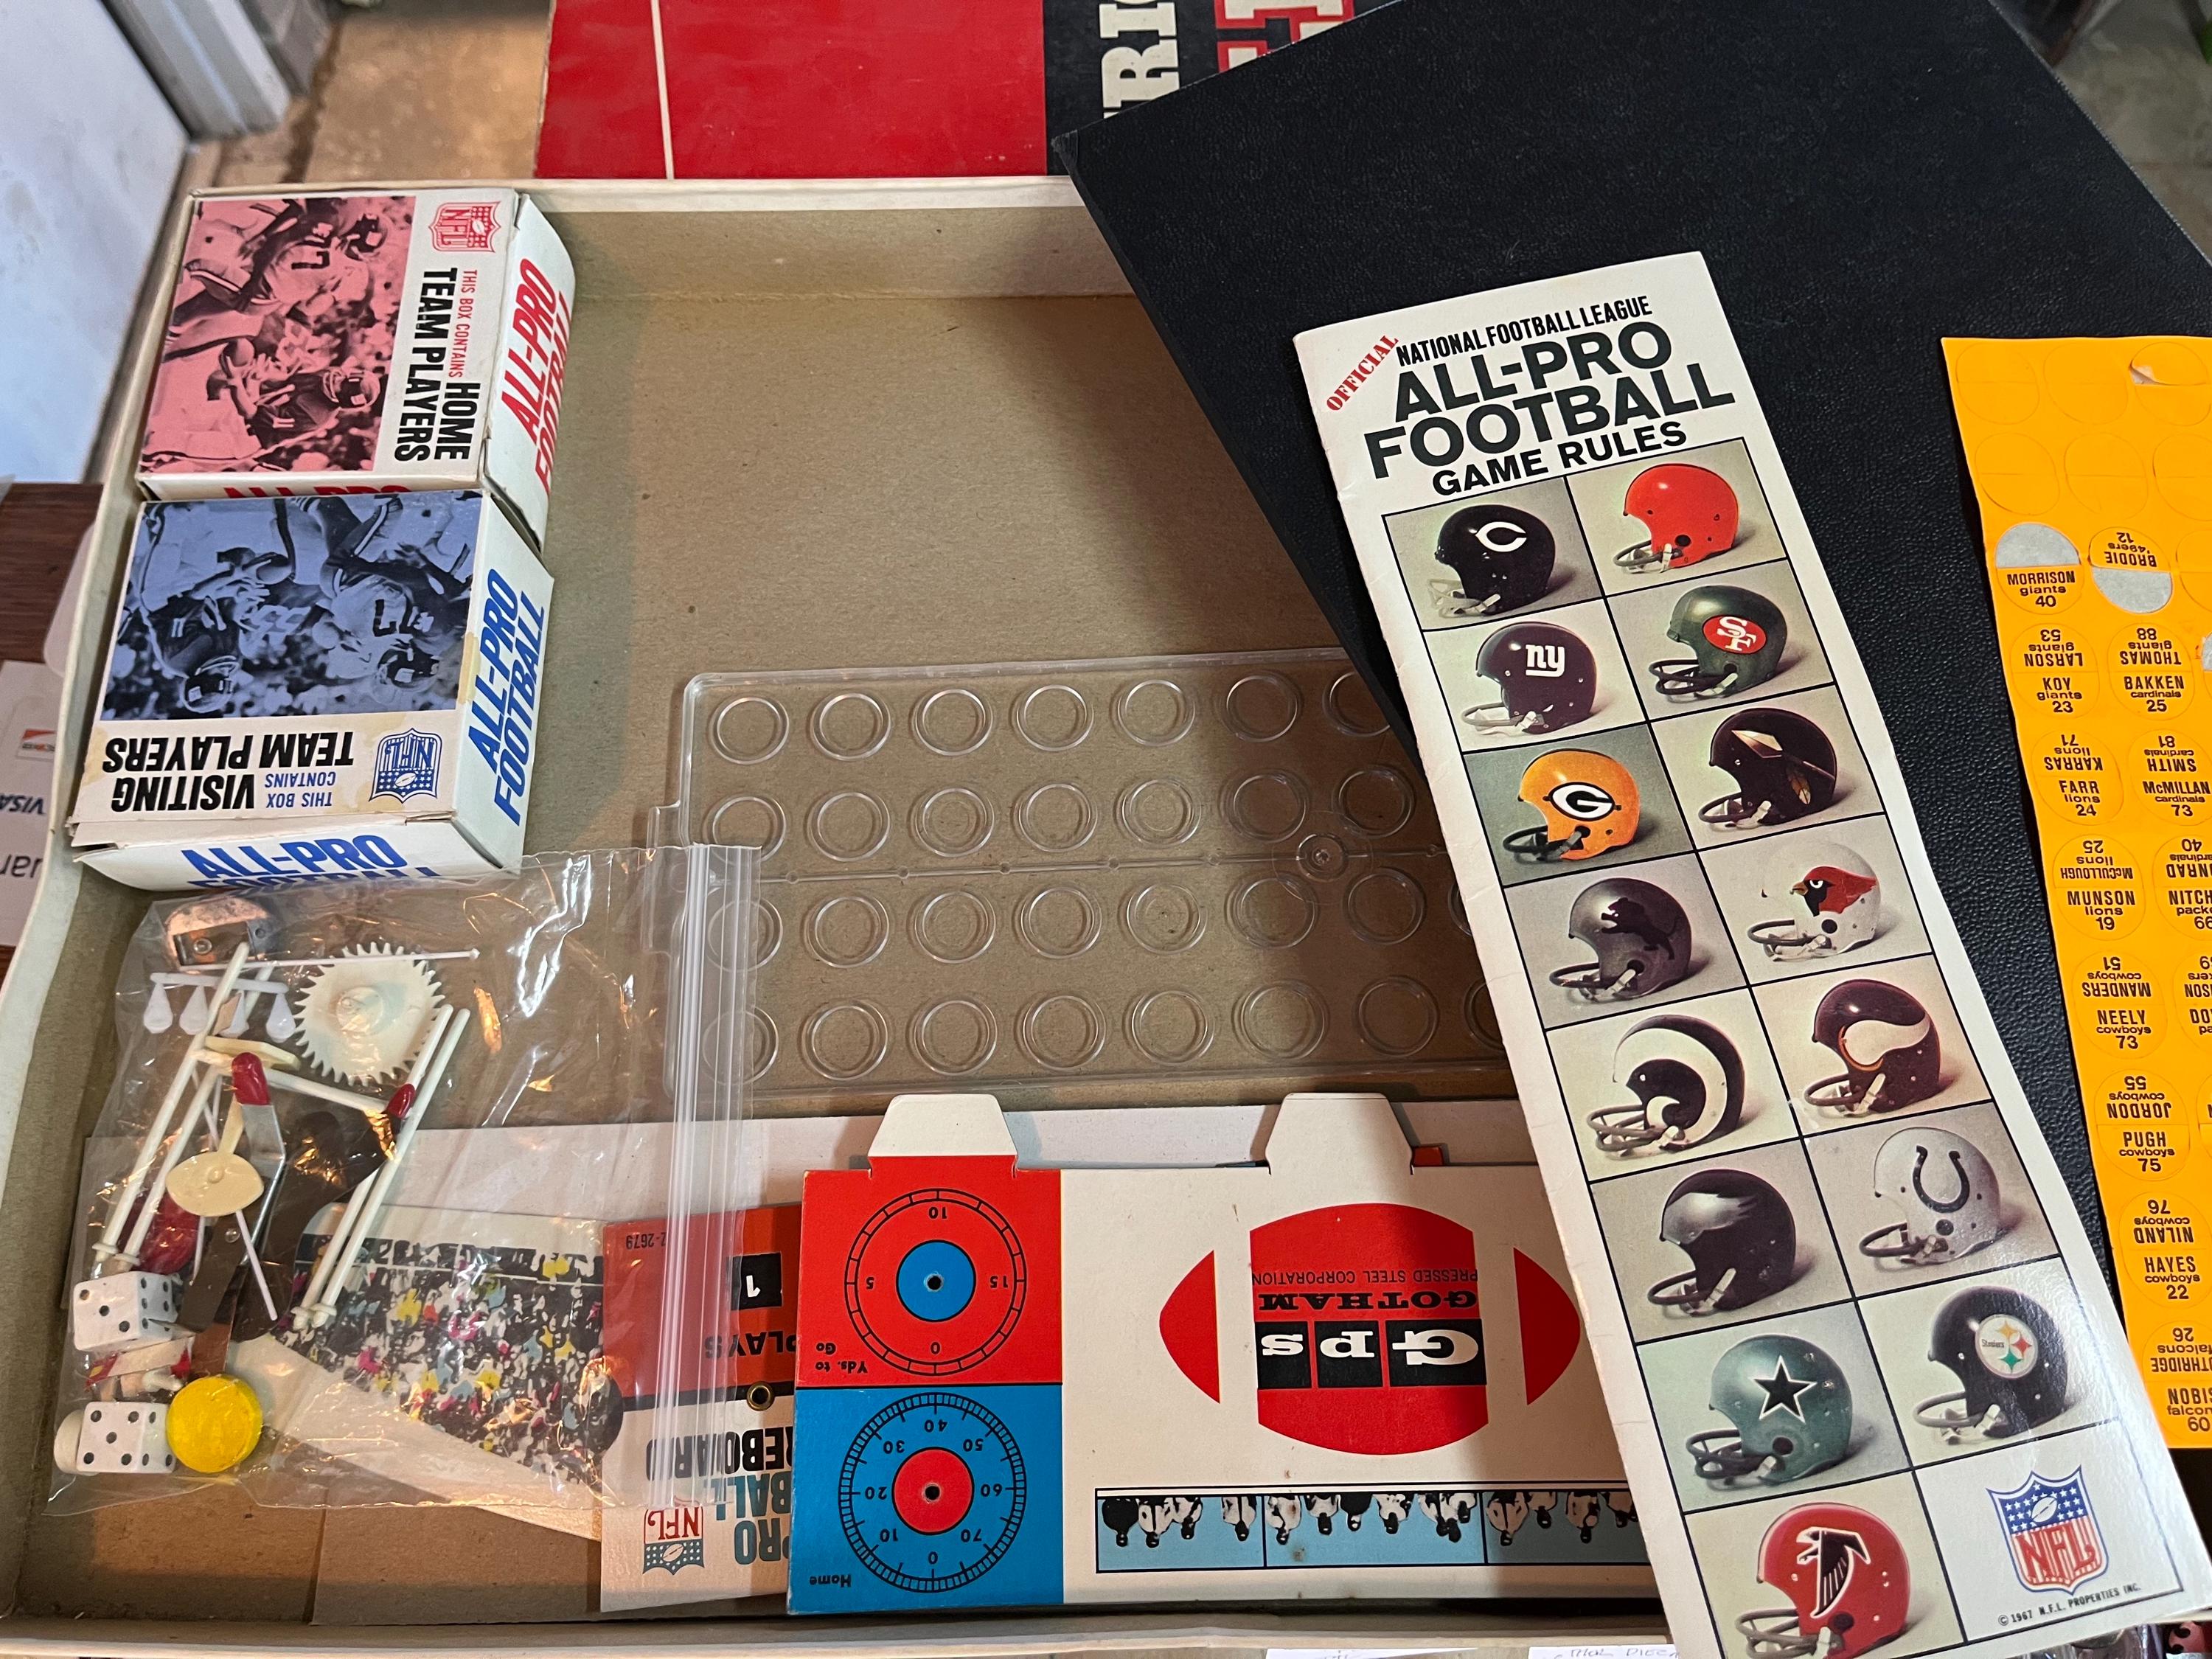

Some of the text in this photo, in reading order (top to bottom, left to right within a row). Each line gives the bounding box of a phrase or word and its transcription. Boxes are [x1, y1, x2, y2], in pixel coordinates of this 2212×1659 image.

[448, 270, 478, 378] THIS BOX CONTAINS
[1396, 295, 1653, 366] NATIONAL FOOTBALL LEAGUE
[501, 257, 557, 445] ALL-PRO
[394, 268, 458, 462] TEAM PLAYERS
[1395, 321, 1672, 423] ALL-PRO
[1325, 334, 1399, 411] OFFICIAL
[434, 382, 481, 460] HOME
[1363, 362, 1736, 479] FOOTBALL
[1432, 420, 1688, 497] GAME RULES
[2117, 532, 2134, 543] 12
[2104, 552, 2157, 567] BRODIE
[2007, 571, 2076, 585] MORRISON
[2020, 585, 2066, 596] giants
[2036, 596, 2056, 607] 40
[2040, 629, 2061, 641] 53
[2137, 627, 2157, 640] 88
[2028, 642, 2074, 652] giants
[2128, 641, 2172, 650] giants
[2024, 653, 2083, 667] LARSON
[2119, 651, 2182, 665] THOMAS
[468, 568, 518, 775] ALL-PRO
[2042, 678, 2070, 691] KOY
[2124, 675, 2185, 689] BAKKEN
[2037, 691, 2082, 700] giants
[2130, 690, 2181, 698] cardinals
[494, 591, 545, 827] FOOTBALL
[2053, 700, 2073, 713] 23
[2146, 700, 2167, 712] 25
[2061, 734, 2079, 746] 71
[2158, 735, 2175, 748] 81
[102, 731, 354, 773] TEAM PLAYERS
[385, 739, 435, 769] NFL
[2054, 747, 2090, 756] lions
[2144, 748, 2194, 757] cardinals
[2044, 757, 2103, 771] KARRAS
[2146, 758, 2197, 772] SMITH
[264, 771, 336, 788] CONTAINS
[111, 774, 254, 813] VISITING
[2059, 780, 2100, 794] FARR
[2143, 781, 2211, 795] McMILLAN
[265, 791, 333, 809] THIS BOX
[2064, 794, 2100, 803] lions
[2155, 795, 2205, 803] cardinals
[2076, 804, 2096, 816] 24
[2171, 804, 2193, 816] 73
[2083, 840, 2103, 854] 25
[2181, 838, 2202, 852] 40
[181, 835, 408, 879] ALL-PRO
[2076, 856, 2112, 866] lions
[2060, 867, 2133, 880] McCULLOUGH
[2166, 863, 2212, 878] NRAD
[2067, 890, 2135, 905] MUNSON
[2084, 905, 2123, 916] lions
[2096, 917, 2115, 931] 19
[2103, 956, 2121, 970] 51
[2087, 972, 2141, 981] cowboys
[2081, 982, 2152, 998] MANDERS
[2184, 984, 2212, 998] SON
[2097, 1009, 2146, 1025] NEELY
[2189, 1008, 2212, 1024] DO
[2096, 1026, 2152, 1035] cowboys
[2115, 1035, 2138, 1050] 73
[2124, 1076, 2147, 1091] 55
[2109, 1092, 2165, 1101] cowboys
[2107, 1102, 2171, 1119] JORDON
[2123, 1131, 2166, 1147] PUGH
[2119, 1147, 2175, 1158] cowboys
[2138, 1158, 2162, 1172] 75
[928, 1206, 947, 1219] 10
[2147, 1199, 2171, 1215] 76
[2134, 1216, 2191, 1225] cowboys
[2133, 1226, 2194, 1244] NILAND
[2144, 1255, 2196, 1273] HAYES
[866, 1276, 874, 1290] 5
[990, 1276, 1009, 1289] 15
[1253, 1269, 1478, 1285] PRESSED STEEL CORPORATION
[2144, 1273, 2201, 1284] cowboys
[745, 1275, 761, 1297] 1
[2166, 1284, 2189, 1301] 22
[1258, 1290, 1478, 1310] GOTHAM
[2172, 1326, 2194, 1343] 26
[815, 1342, 836, 1355] Go
[931, 1341, 941, 1354] 0
[815, 1360, 868, 1374] Yds. to
[924, 1419, 948, 1433] 40
[2187, 1416, 2211, 1433] 60
[883, 1440, 905, 1454] 30
[963, 1439, 984, 1452] 50
[865, 1486, 888, 1500] 20
[981, 1484, 1002, 1497] 60
[647, 1506, 700, 1540] NFL
[880, 1528, 898, 1543] 10
[961, 1528, 982, 1543] 70
[928, 1551, 938, 1565] 0
[2015, 1523, 2096, 1580] NFL
[810, 1574, 852, 1587] Home
[2011, 1610, 2033, 1623] 1967
[2038, 1601, 2066, 1615] N.F.L.
[2067, 1588, 2121, 1609] PROPERTIES
[2123, 1582, 2141, 1594] INC.
